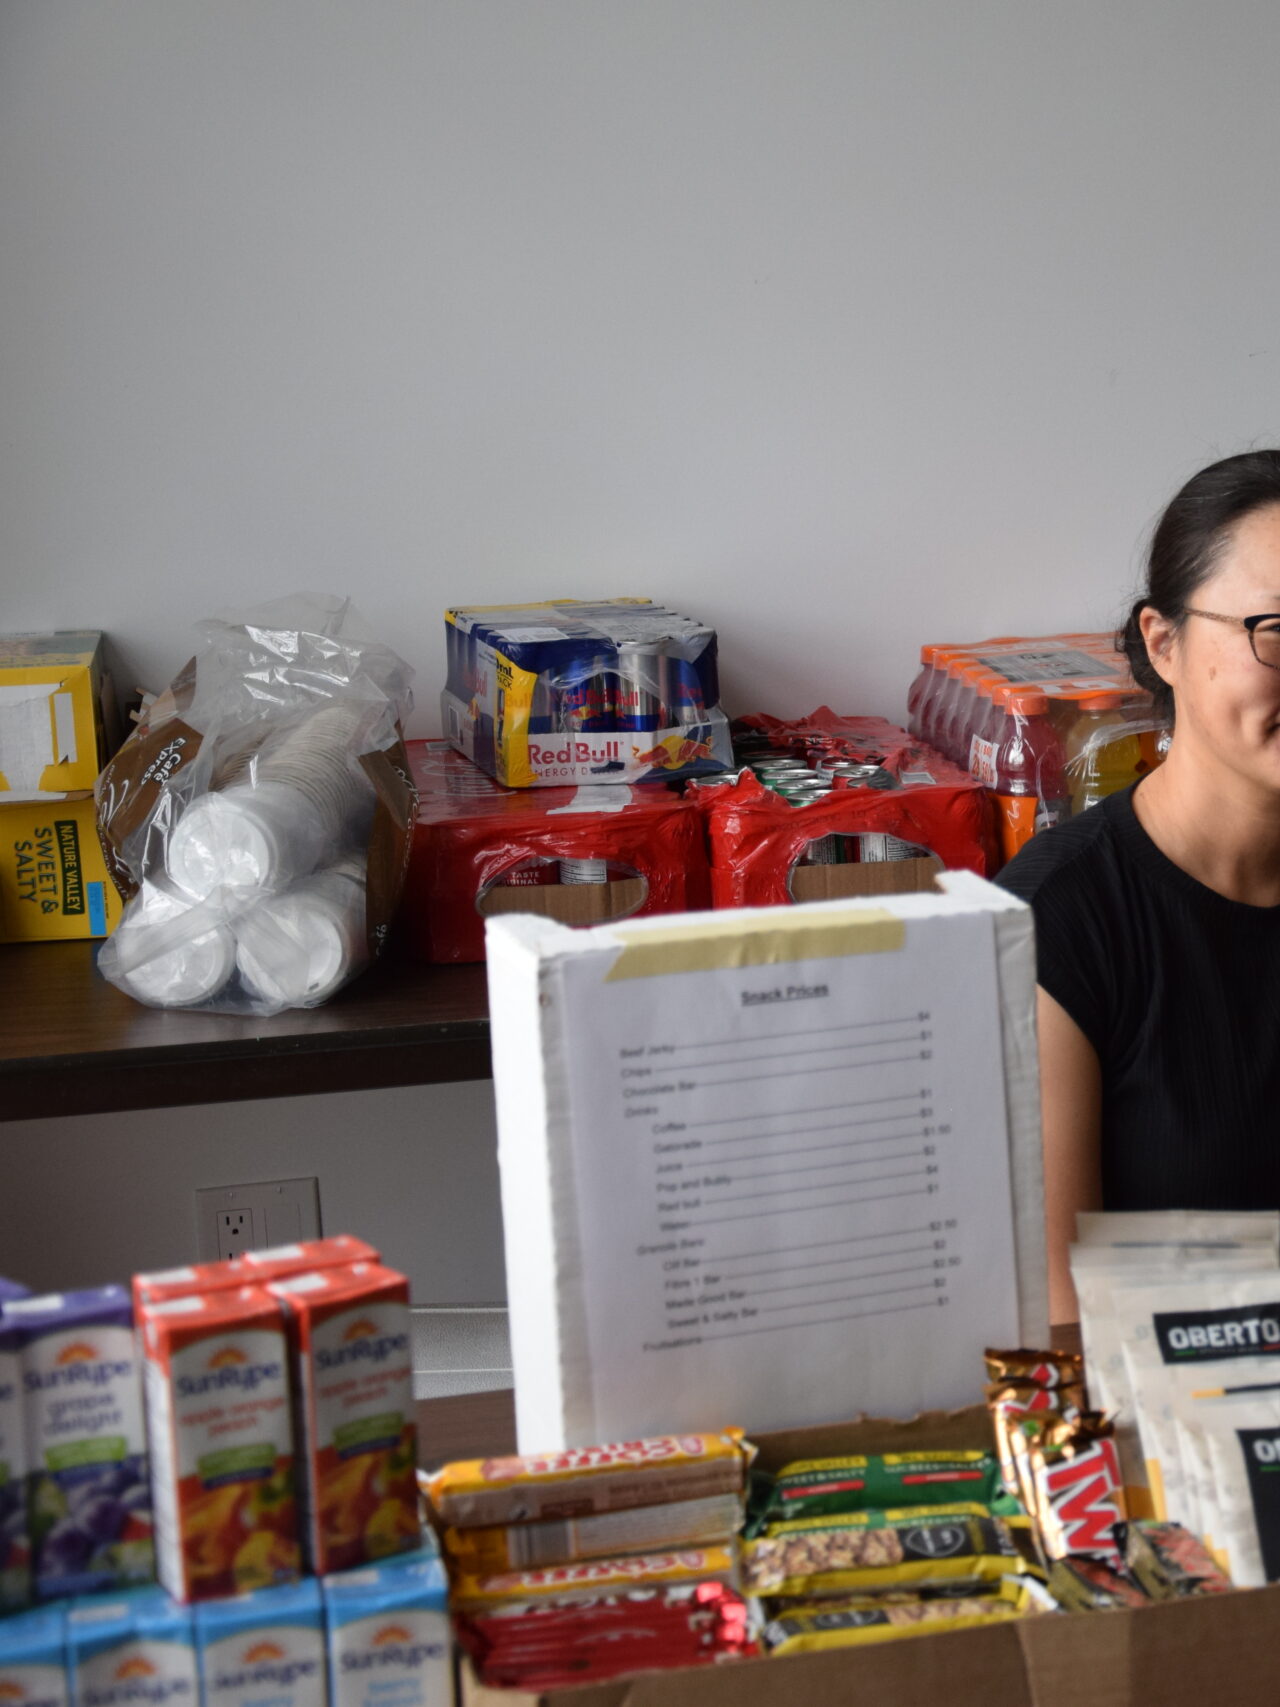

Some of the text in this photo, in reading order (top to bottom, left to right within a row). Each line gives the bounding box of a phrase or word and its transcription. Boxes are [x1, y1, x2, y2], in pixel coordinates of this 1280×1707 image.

[528, 740, 619, 765] Red Bull
[533, 766, 576, 778] NERGY
[14, 840, 38, 903] SALTY
[34, 826, 59, 914] SWEET &
[59, 824, 82, 912] NATURE VALLEY
